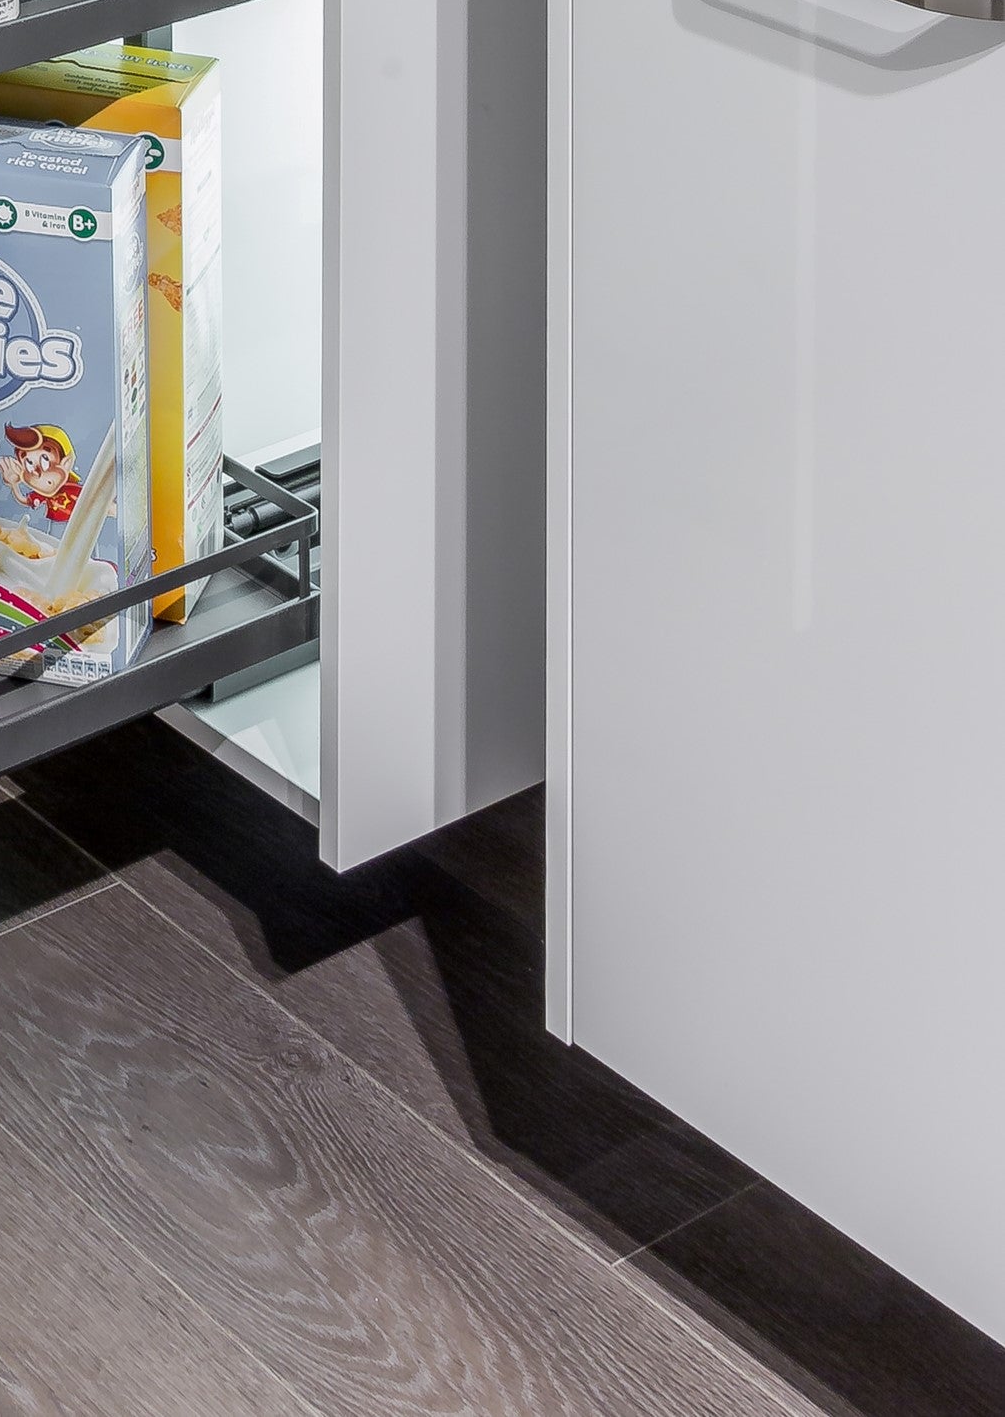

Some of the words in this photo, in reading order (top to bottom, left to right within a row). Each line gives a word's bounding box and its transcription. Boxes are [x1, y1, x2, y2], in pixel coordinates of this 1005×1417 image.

[116, 54, 143, 63] NUT
[146, 58, 194, 71] FLAKES
[64, 73, 88, 81] Golden
[6, 157, 36, 167] rice
[39, 161, 89, 175] cereal
[22, 151, 82, 167] Toasted
[32, 211, 66, 221] Vitamins
[73, 215, 95, 233] B+
